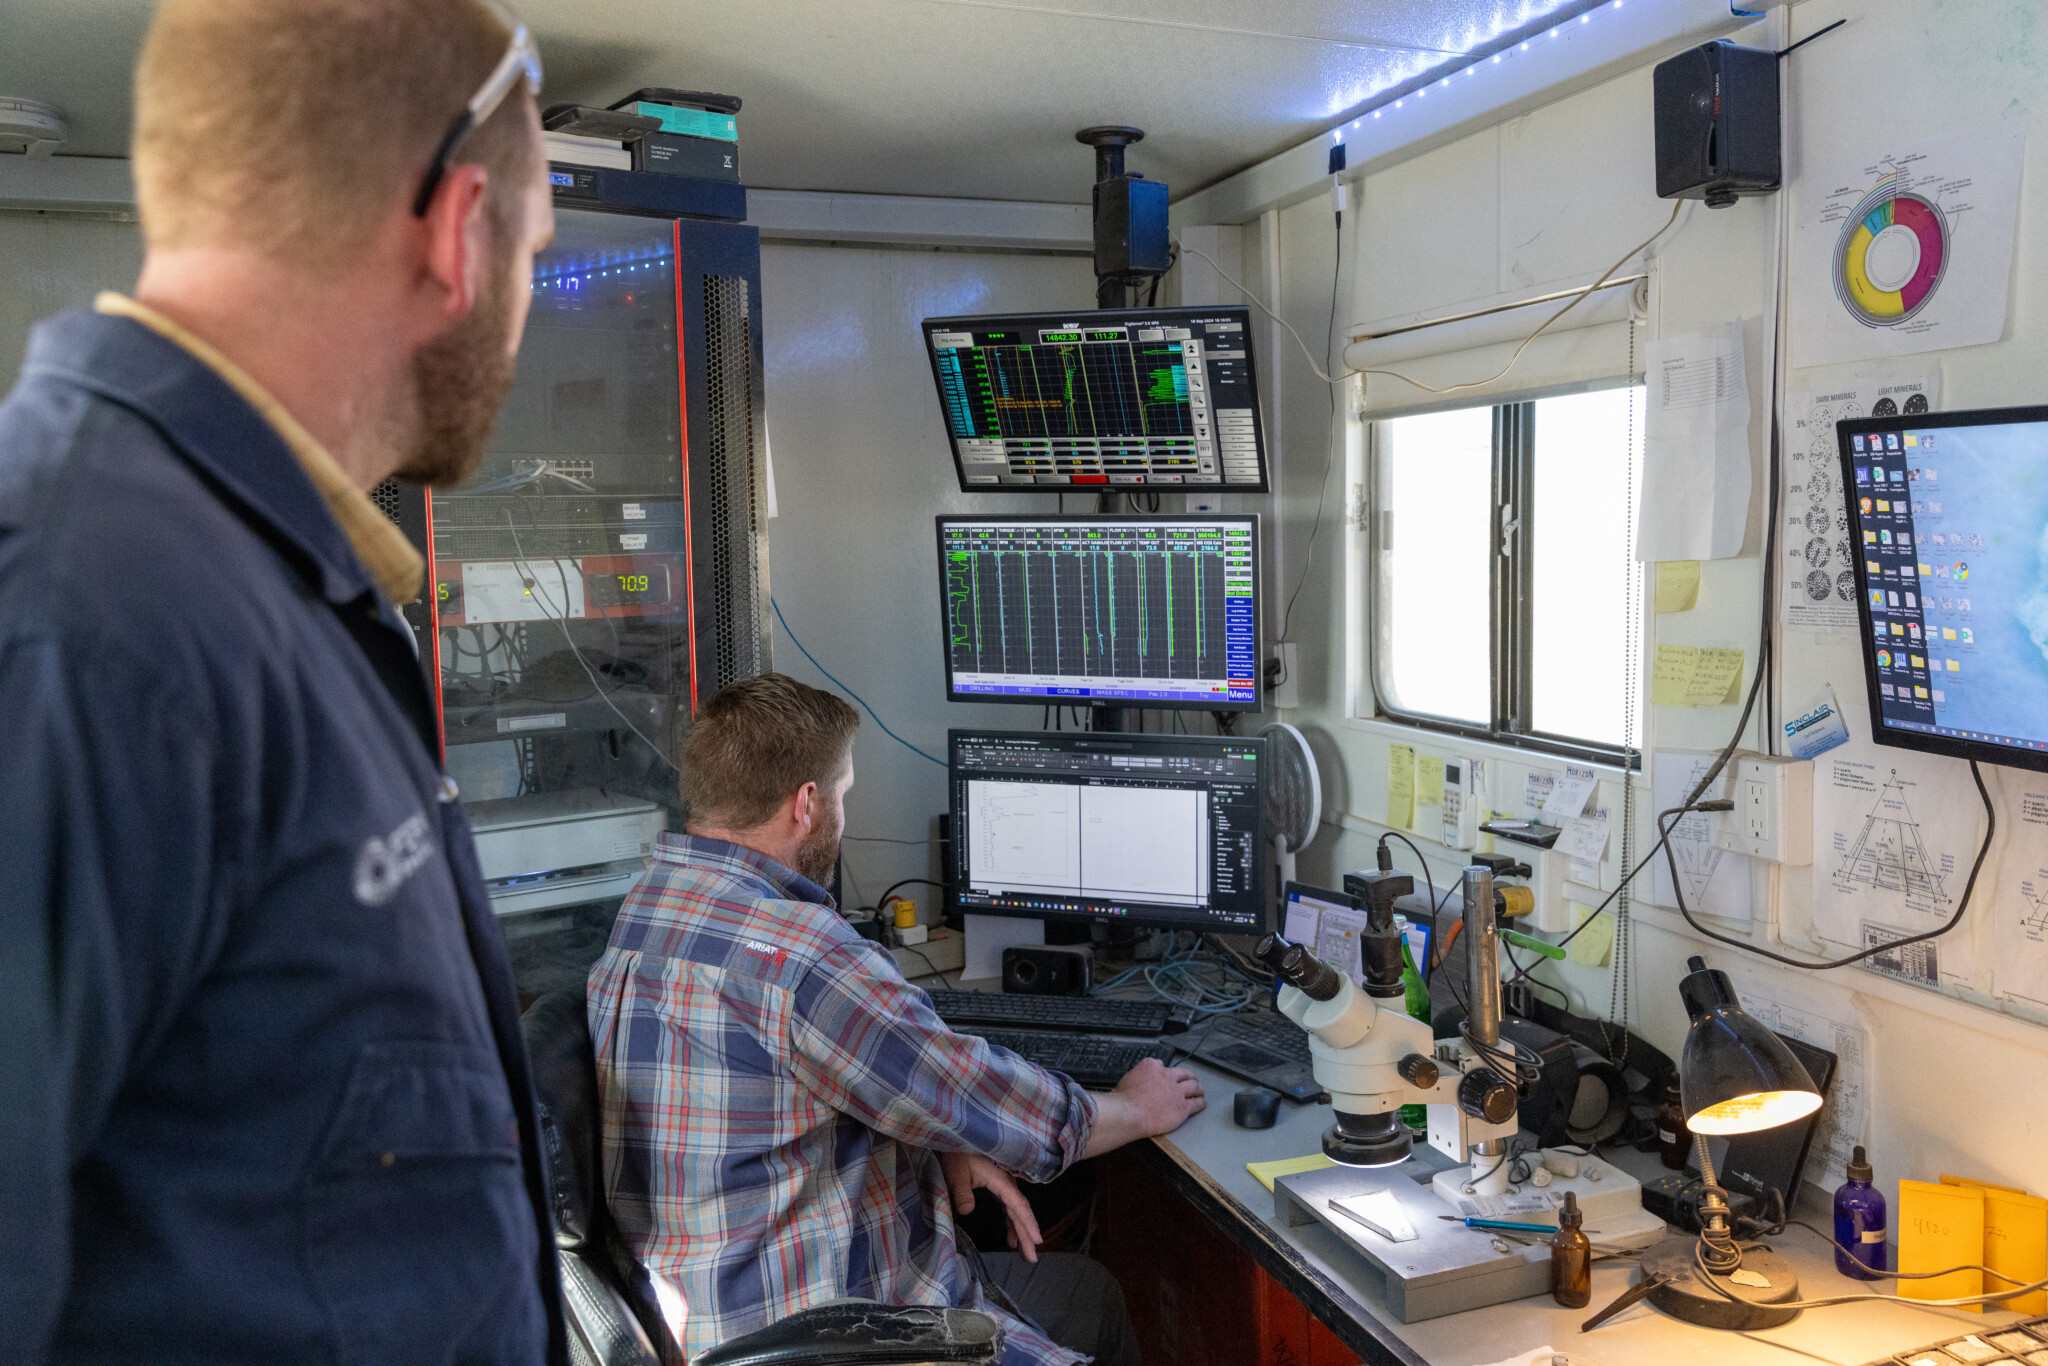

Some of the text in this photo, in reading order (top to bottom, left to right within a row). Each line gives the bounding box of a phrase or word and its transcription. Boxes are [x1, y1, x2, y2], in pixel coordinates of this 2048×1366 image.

[1094, 332, 1118, 340] 111.27
[1878, 383, 1922, 395] LIGHT MINERALS
[1816, 392, 1857, 403] DARK MINERALS
[1797, 420, 1806, 428] 5%
[1793, 452, 1804, 460] 10%
[1790, 485, 1802, 493] 20%
[1789, 517, 1801, 525] 30%
[618, 576, 648, 592] 70.9
[1229, 691, 1253, 699] Menu
[1785, 704, 1835, 737] SINCLAIR
[1869, 935, 1878, 944] US
[746, 941, 778, 955] ARIAT
